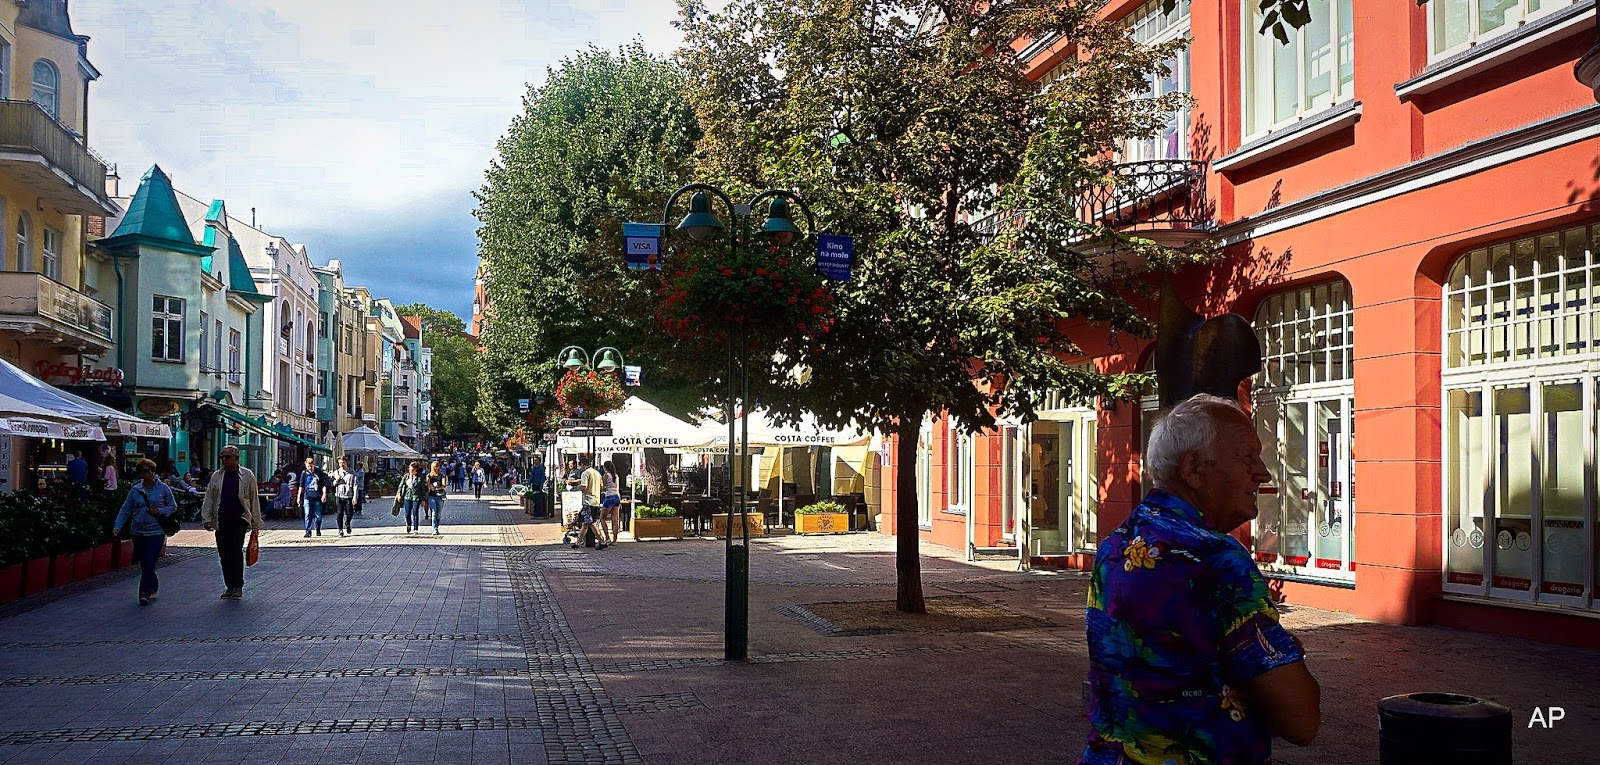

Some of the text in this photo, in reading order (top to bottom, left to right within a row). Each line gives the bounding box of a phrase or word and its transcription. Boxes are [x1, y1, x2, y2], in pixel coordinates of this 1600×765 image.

[632, 242, 652, 250] VISA
[827, 242, 843, 250] Kino
[612, 437, 679, 445] COSTA COFFEE
[775, 435, 802, 443] COSTA
[1550, 585, 1581, 595] drogeria
